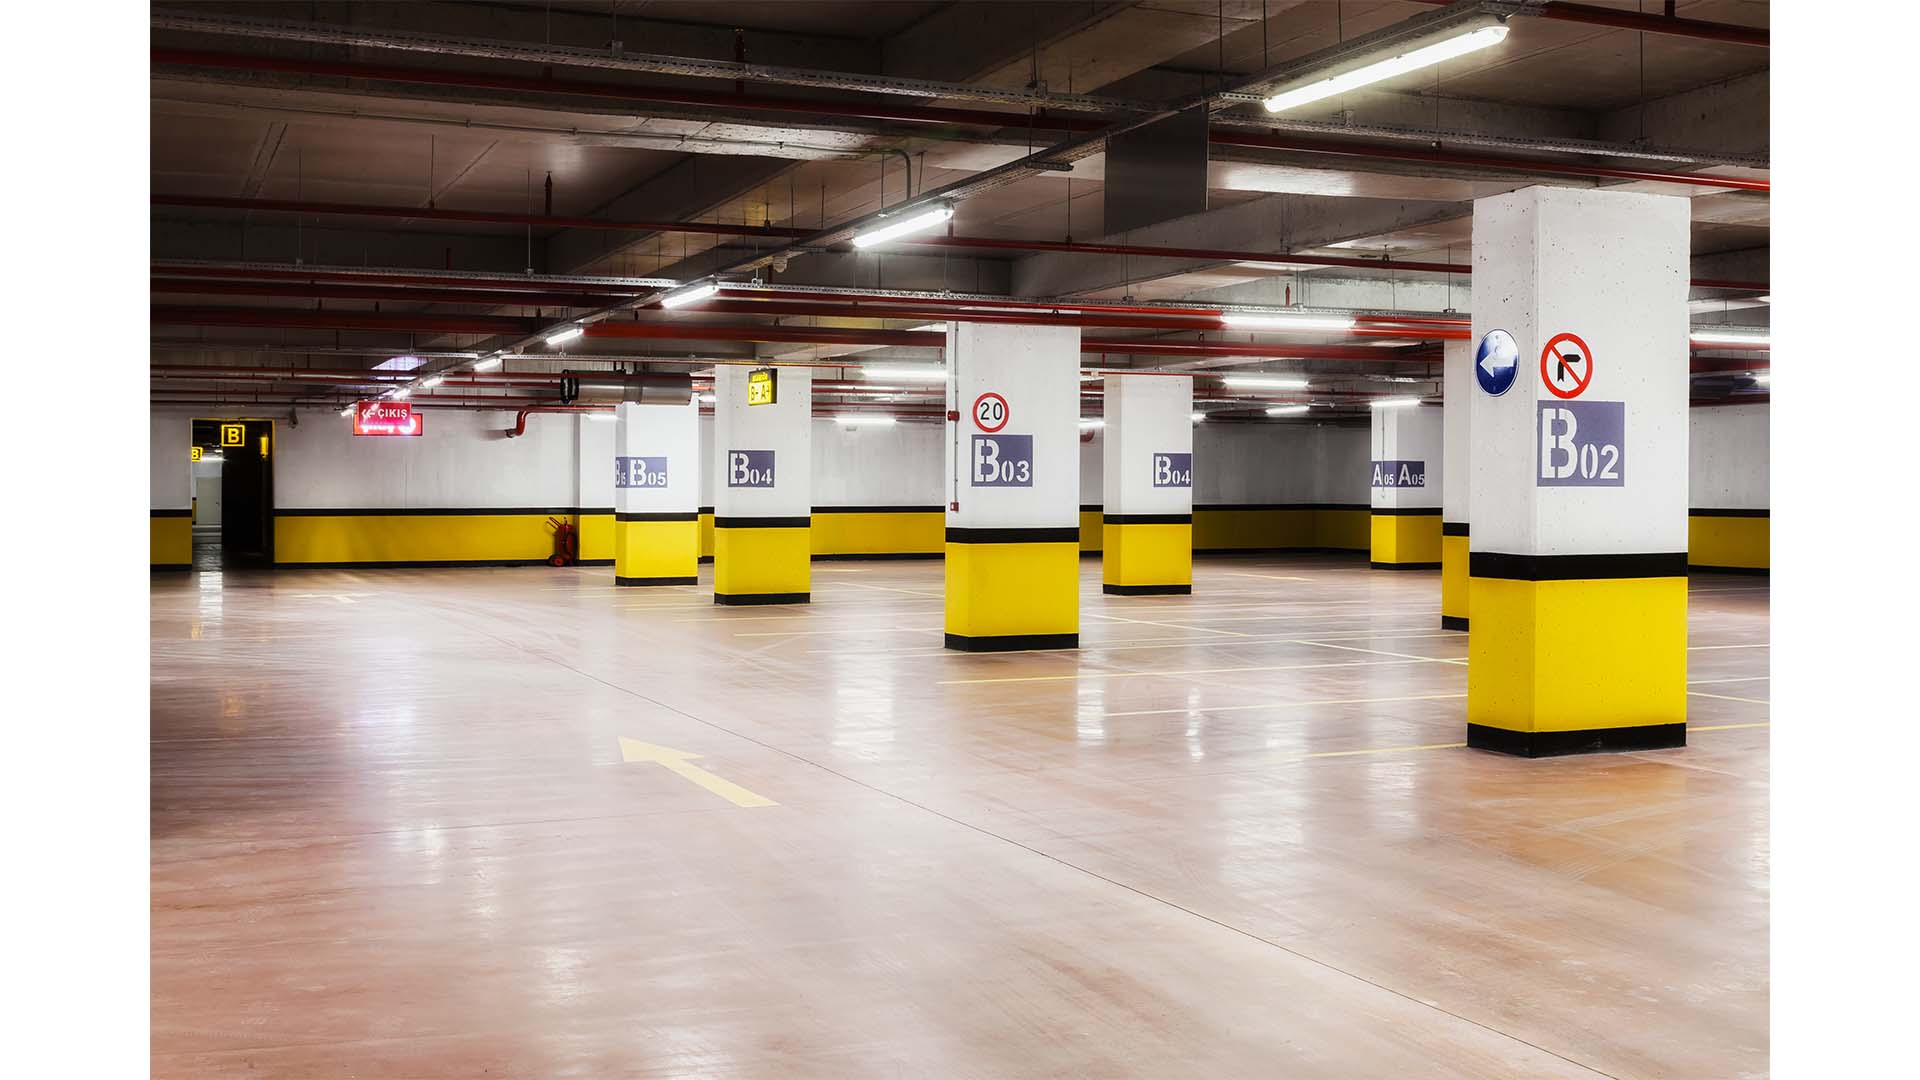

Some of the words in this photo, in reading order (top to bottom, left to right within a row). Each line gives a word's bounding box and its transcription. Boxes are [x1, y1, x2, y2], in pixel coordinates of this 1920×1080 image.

[377, 408, 408, 419] ÇIKIŞ
[980, 402, 1003, 421] 20
[228, 428, 240, 443] B
[1542, 408, 1618, 479] B02
[629, 459, 667, 486] B05
[730, 453, 772, 484] B04
[974, 439, 1030, 482] B03
[1155, 456, 1191, 485] B04
[1372, 464, 1394, 485] A05
[1398, 464, 1425, 485] A05
